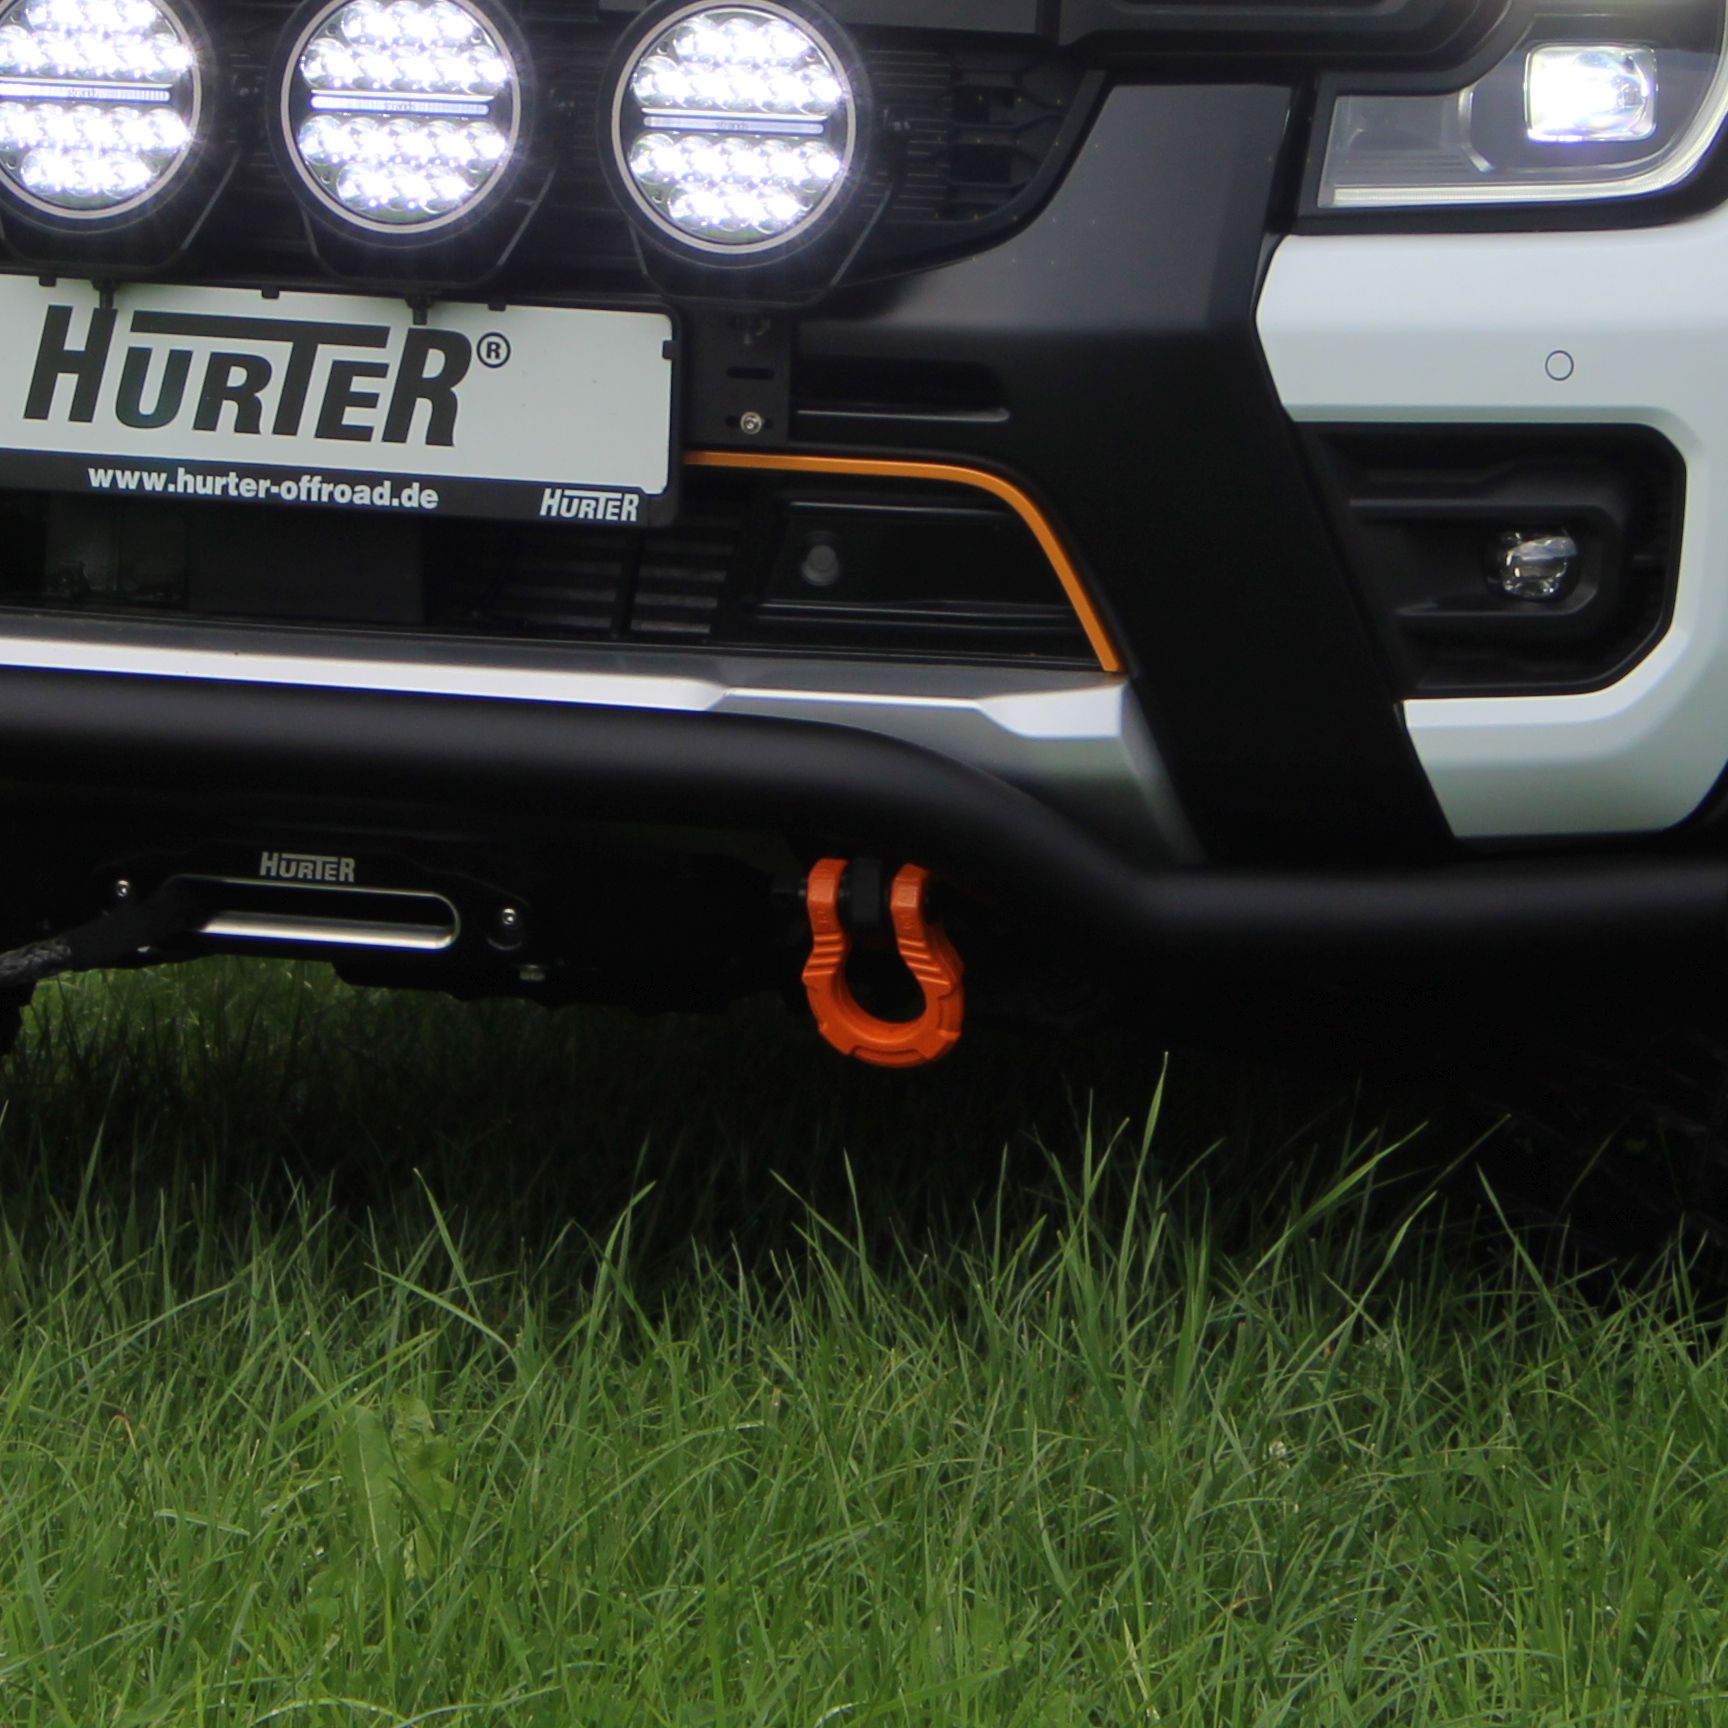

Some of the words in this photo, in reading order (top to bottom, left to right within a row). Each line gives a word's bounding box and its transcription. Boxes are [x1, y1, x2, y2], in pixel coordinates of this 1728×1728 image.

[88, 465, 439, 510] www.hurter-offroad.de
[538, 487, 640, 524] HURTER
[259, 851, 356, 884] HURTER
